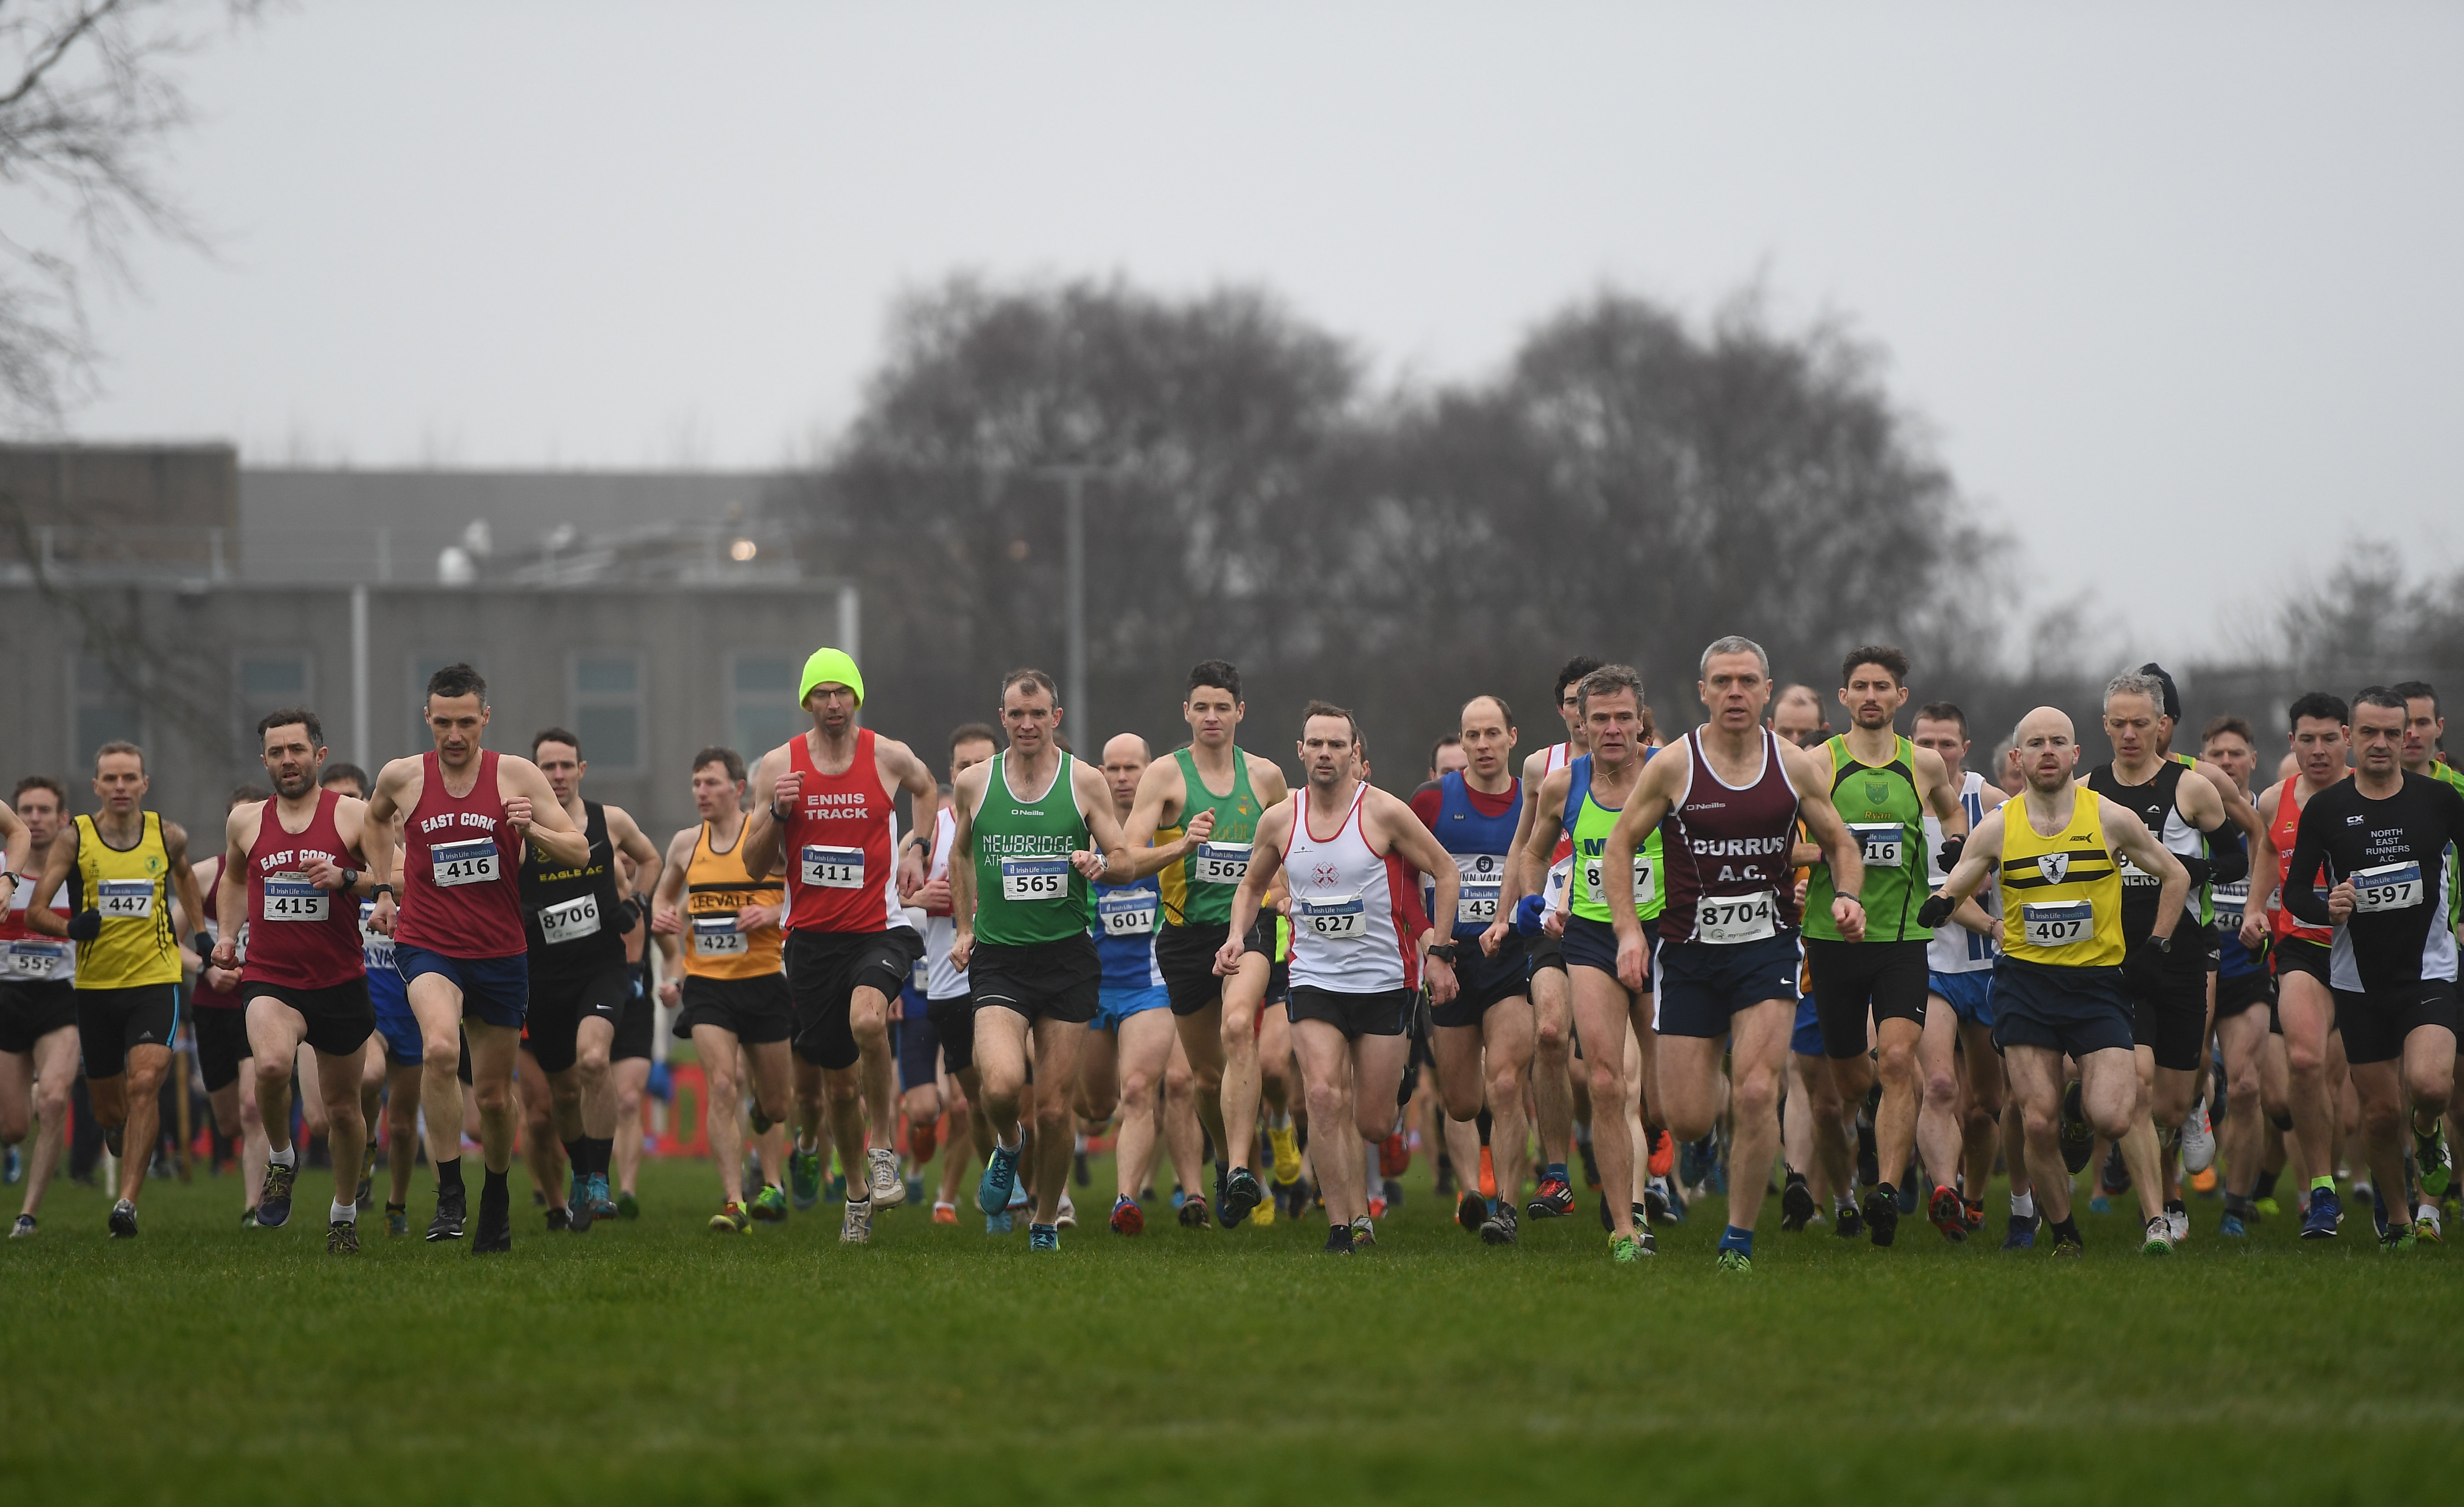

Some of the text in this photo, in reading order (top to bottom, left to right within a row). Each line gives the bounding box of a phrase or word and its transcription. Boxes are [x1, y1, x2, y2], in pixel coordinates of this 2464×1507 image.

[807, 793, 865, 805] ENNIS
[804, 808, 868, 820] TRACK
[1865, 811, 1891, 821] Ryan
[421, 812, 497, 834] EAST CORK
[2371, 828, 2403, 838] NORTH
[983, 835, 1073, 853] NEWBRIDGE
[1693, 836, 1785, 856] DURRUS
[2376, 837, 2399, 846] EAST
[1869, 844, 1895, 860] 16
[2365, 845, 2410, 855] RUNNERS
[260, 850, 293, 871] EAST
[447, 859, 490, 878] 416
[1208, 860, 1247, 877] 562
[539, 865, 603, 882] EAGLE AC
[812, 865, 851, 880] 411
[1718, 865, 1766, 881] A.C.
[1016, 876, 1058, 892] 565
[2367, 883, 2411, 904] 597
[109, 896, 147, 910] 447
[275, 898, 317, 914] 415
[1469, 900, 1495, 915] 43
[543, 903, 595, 928] 8706
[1113, 911, 1150, 928] 601
[1703, 901, 1769, 925] 8704
[1315, 915, 1354, 932] 627
[2036, 921, 2081, 939] 407
[704, 934, 738, 949] 422
[1728, 929, 1761, 939] myrunresults
